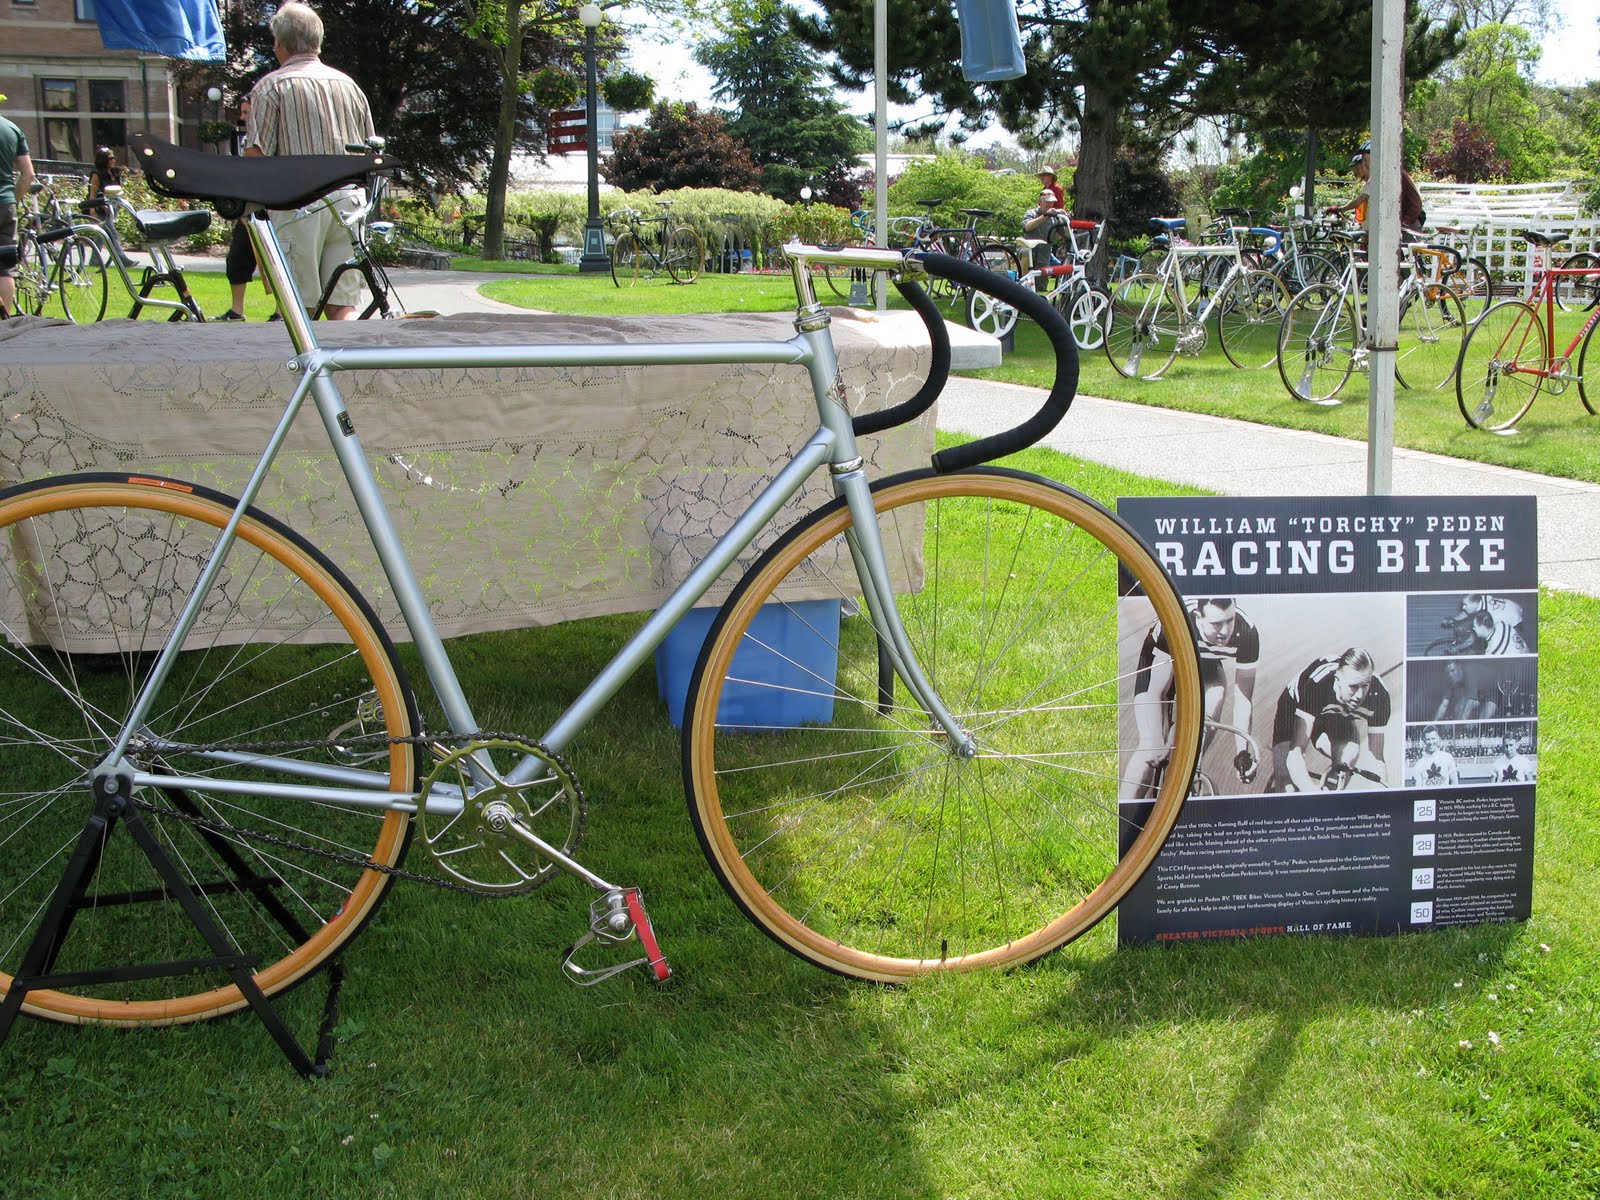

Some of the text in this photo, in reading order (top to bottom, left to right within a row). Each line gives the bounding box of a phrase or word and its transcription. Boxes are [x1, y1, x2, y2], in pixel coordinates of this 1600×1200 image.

[1155, 516, 1506, 534] WILLIAM “TORCHY” PEDEN
[1155, 538, 1506, 576] RACING BIKE
[1176, 897, 1196, 905] grateful
[1247, 901, 1276, 910] forthcoming
[1286, 924, 1310, 932] HALL
[1326, 922, 1352, 930] FAME
